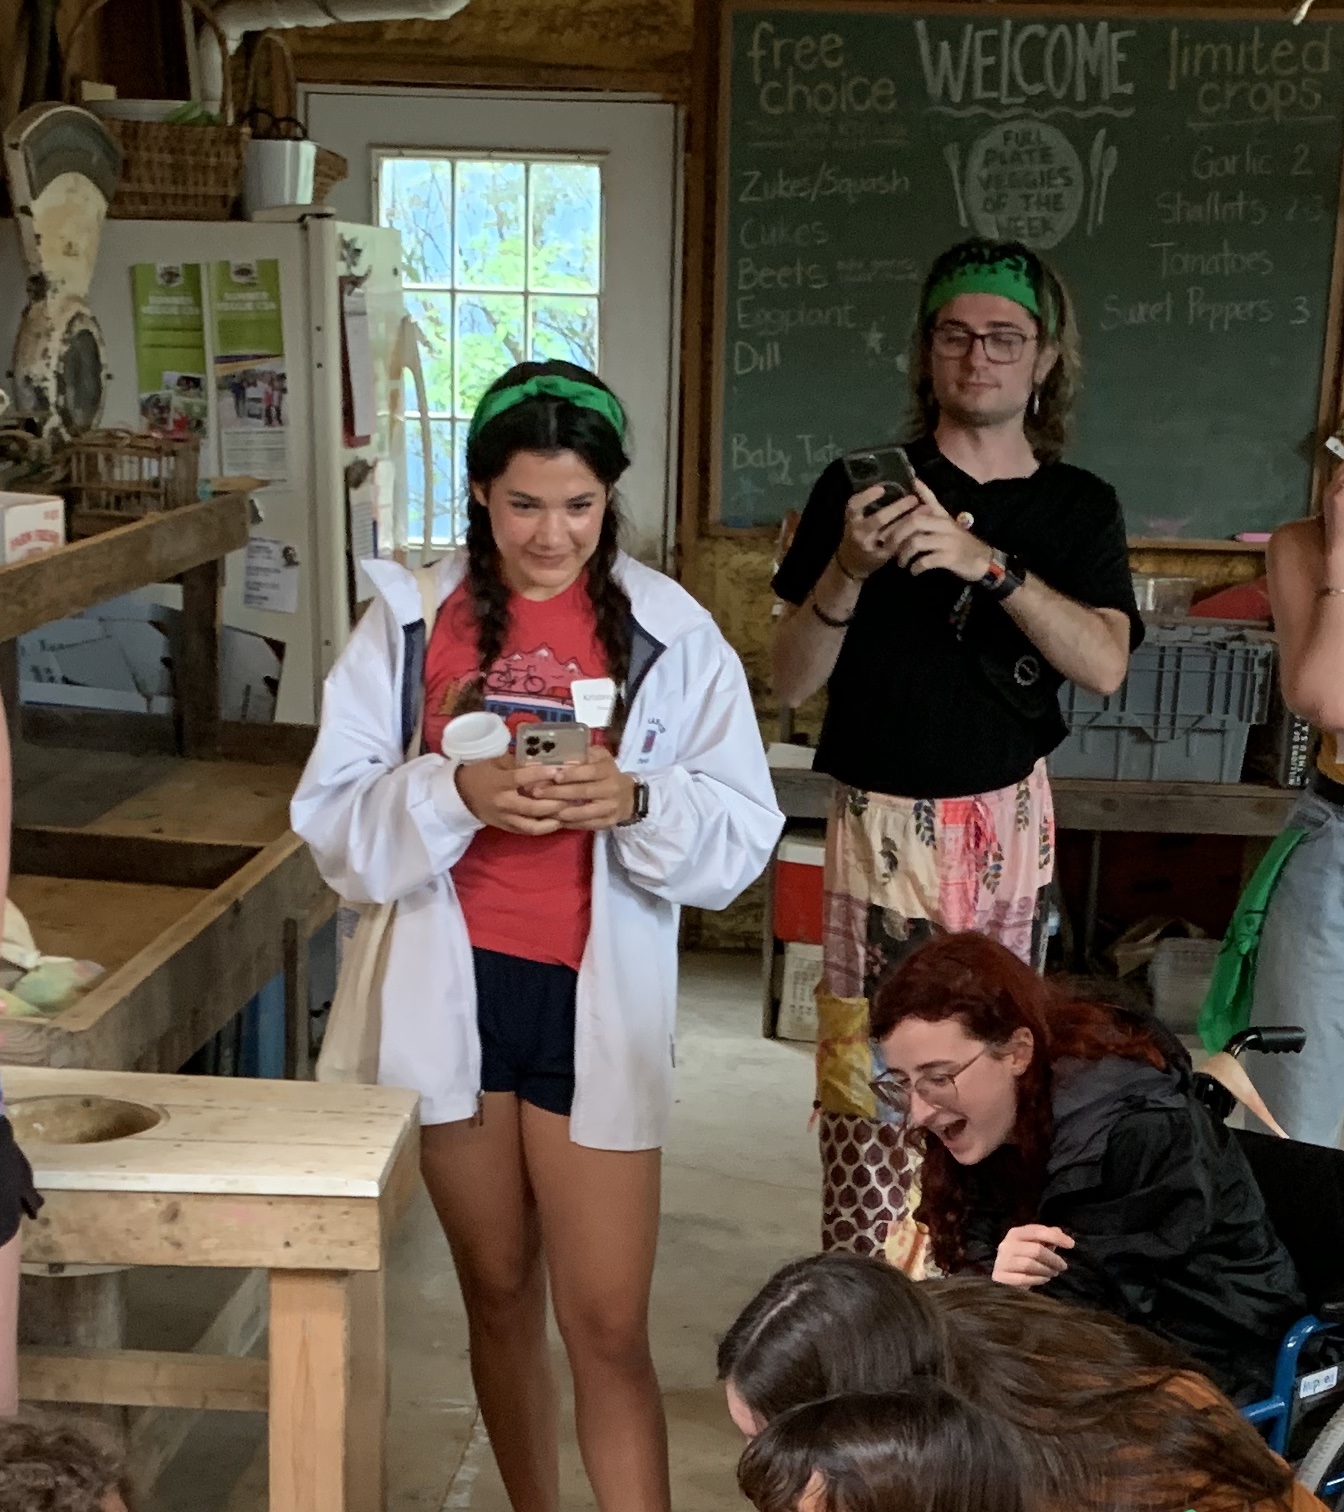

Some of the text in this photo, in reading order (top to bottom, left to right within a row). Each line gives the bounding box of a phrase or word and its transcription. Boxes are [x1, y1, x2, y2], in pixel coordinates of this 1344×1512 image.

[747, 21, 843, 85] free
[913, 19, 1136, 104] WELCOME
[1167, 25, 1332, 90] limited
[759, 65, 897, 115] choice
[1197, 78, 1321, 123] crops
[1192, 143, 1313, 180] Garlic 2
[740, 217, 829, 250] Cukes
[737, 258, 829, 290] Beets
[1146, 239, 1274, 279] Tomatoes
[737, 295, 856, 337] Eggplant
[1289, 295, 1311, 325] 3
[734, 340, 780, 376] Dill
[731, 432, 794, 486] Baby
